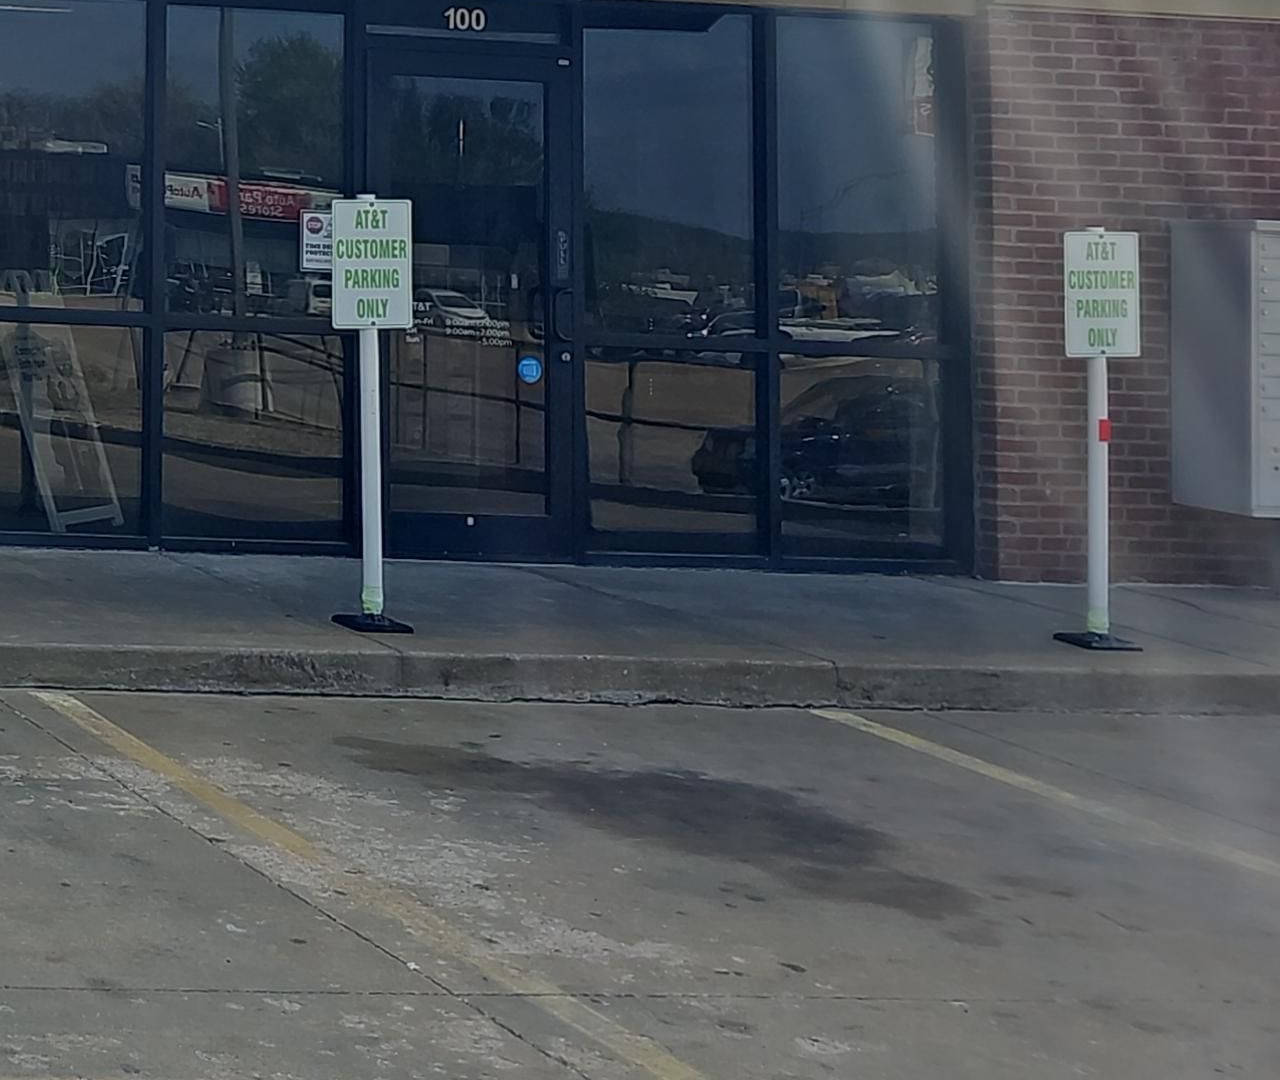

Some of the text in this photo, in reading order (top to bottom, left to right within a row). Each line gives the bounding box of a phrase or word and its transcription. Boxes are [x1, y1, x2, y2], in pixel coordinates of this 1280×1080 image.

[443, 7, 486, 31] 100
[355, 210, 388, 229] AT&T
[336, 239, 407, 259] CUSTOMER
[1086, 242, 1117, 260] AT&T
[344, 269, 399, 289] PARKING
[1068, 270, 1135, 290] CUSTOMER
[357, 299, 389, 318] ONLY
[1076, 299, 1128, 318] PARKING
[1088, 328, 1118, 347] ONLY
